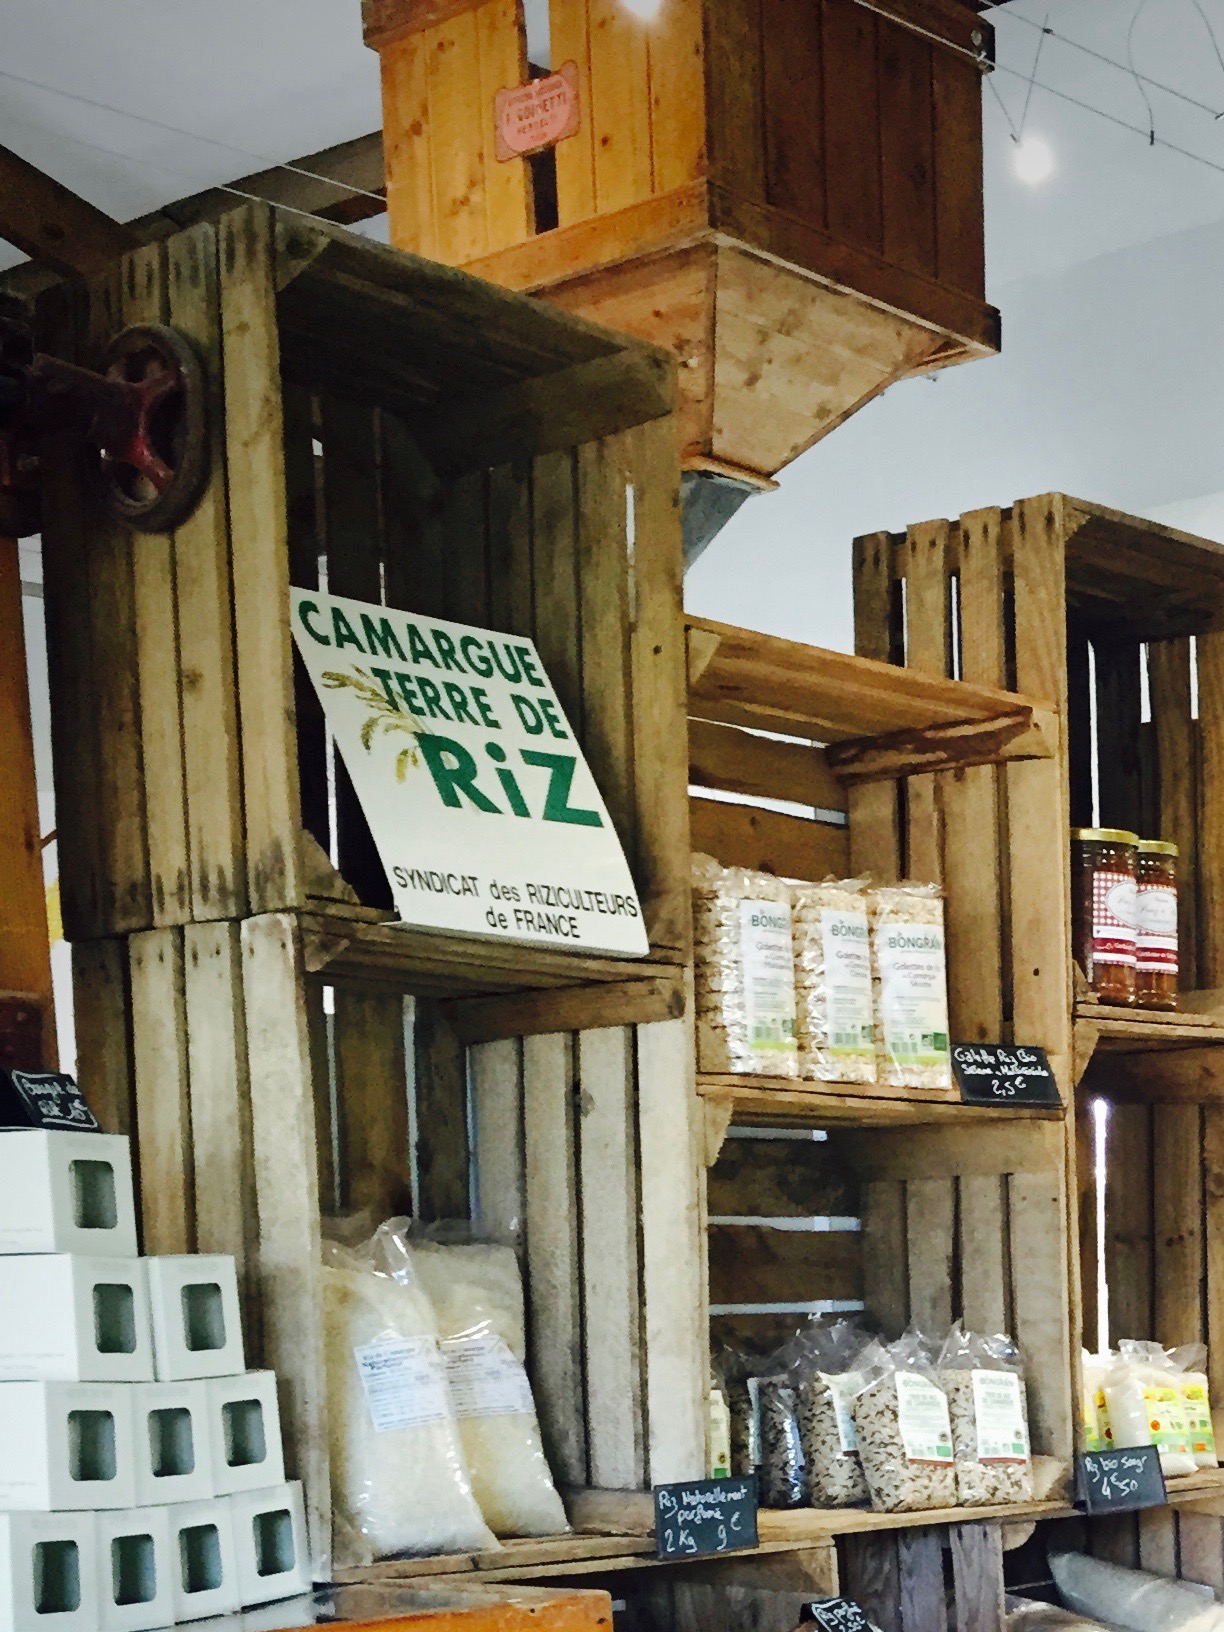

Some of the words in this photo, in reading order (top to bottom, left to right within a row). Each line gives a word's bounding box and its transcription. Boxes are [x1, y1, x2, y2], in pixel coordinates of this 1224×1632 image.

[298, 600, 546, 687] CAMARGUE
[372, 667, 501, 729] TERRE
[516, 694, 568, 739] DE
[393, 866, 479, 898] SYNDICAT
[489, 880, 520, 903] des
[527, 884, 638, 918] RIZICULTEURS
[486, 906, 508, 930] de
[514, 911, 580, 939] FRANCE
